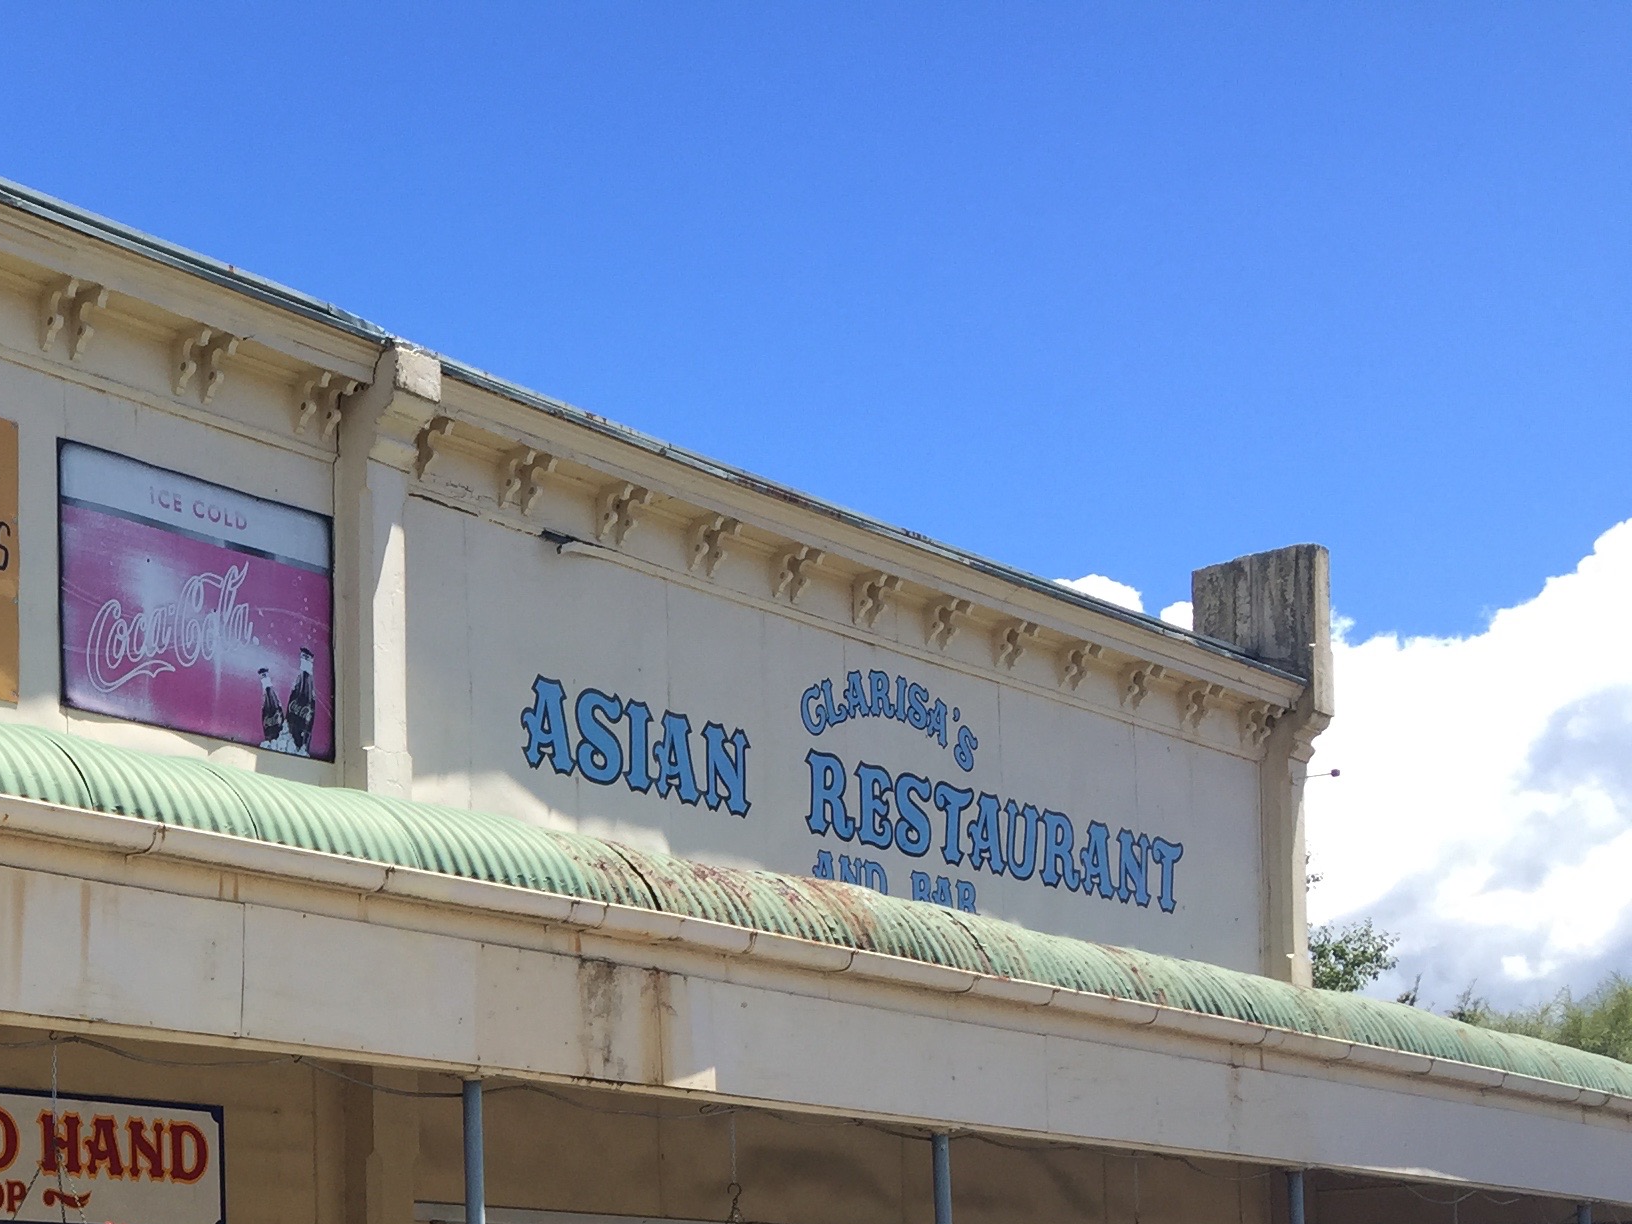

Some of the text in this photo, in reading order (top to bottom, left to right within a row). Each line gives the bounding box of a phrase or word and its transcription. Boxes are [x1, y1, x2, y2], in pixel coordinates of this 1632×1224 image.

[149, 486, 247, 530] ICE COLD
[801, 669, 979, 772] CLARISA'S
[522, 674, 1184, 913] ASIAN RESTAURANT
[911, 870, 980, 915] BAR
[37, 1110, 209, 1184] HAND
